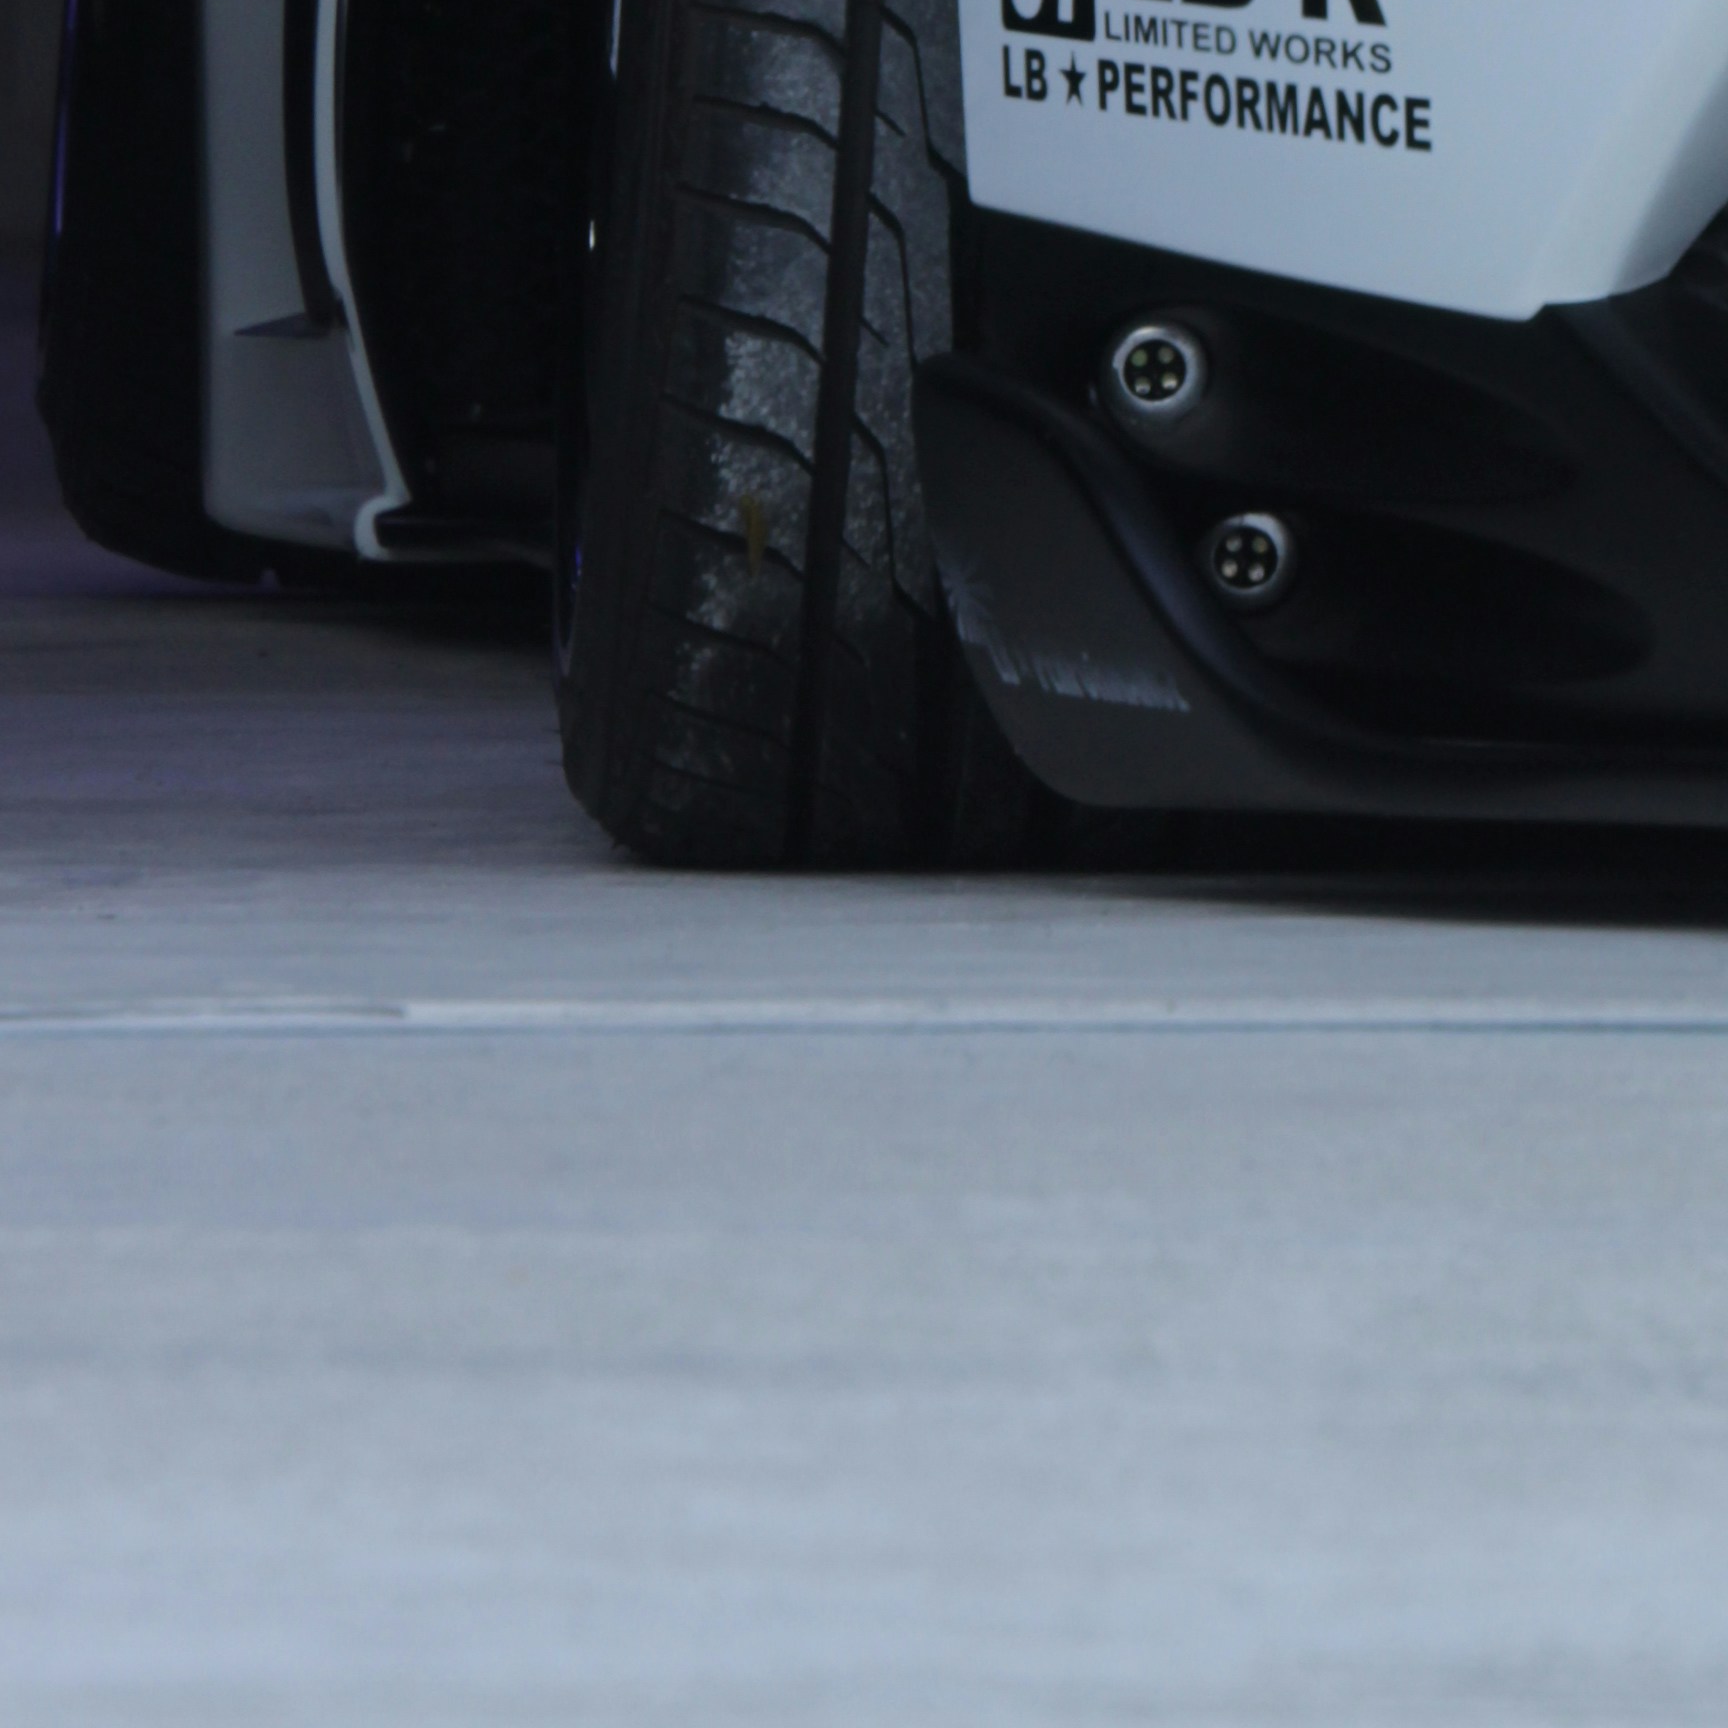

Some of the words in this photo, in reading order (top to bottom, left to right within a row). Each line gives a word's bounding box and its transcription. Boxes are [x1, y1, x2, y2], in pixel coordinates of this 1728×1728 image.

[1104, 10, 1237, 56] LIMITED
[1248, 28, 1393, 74] WORKS
[1097, 57, 1433, 153] PERFORMANCE
